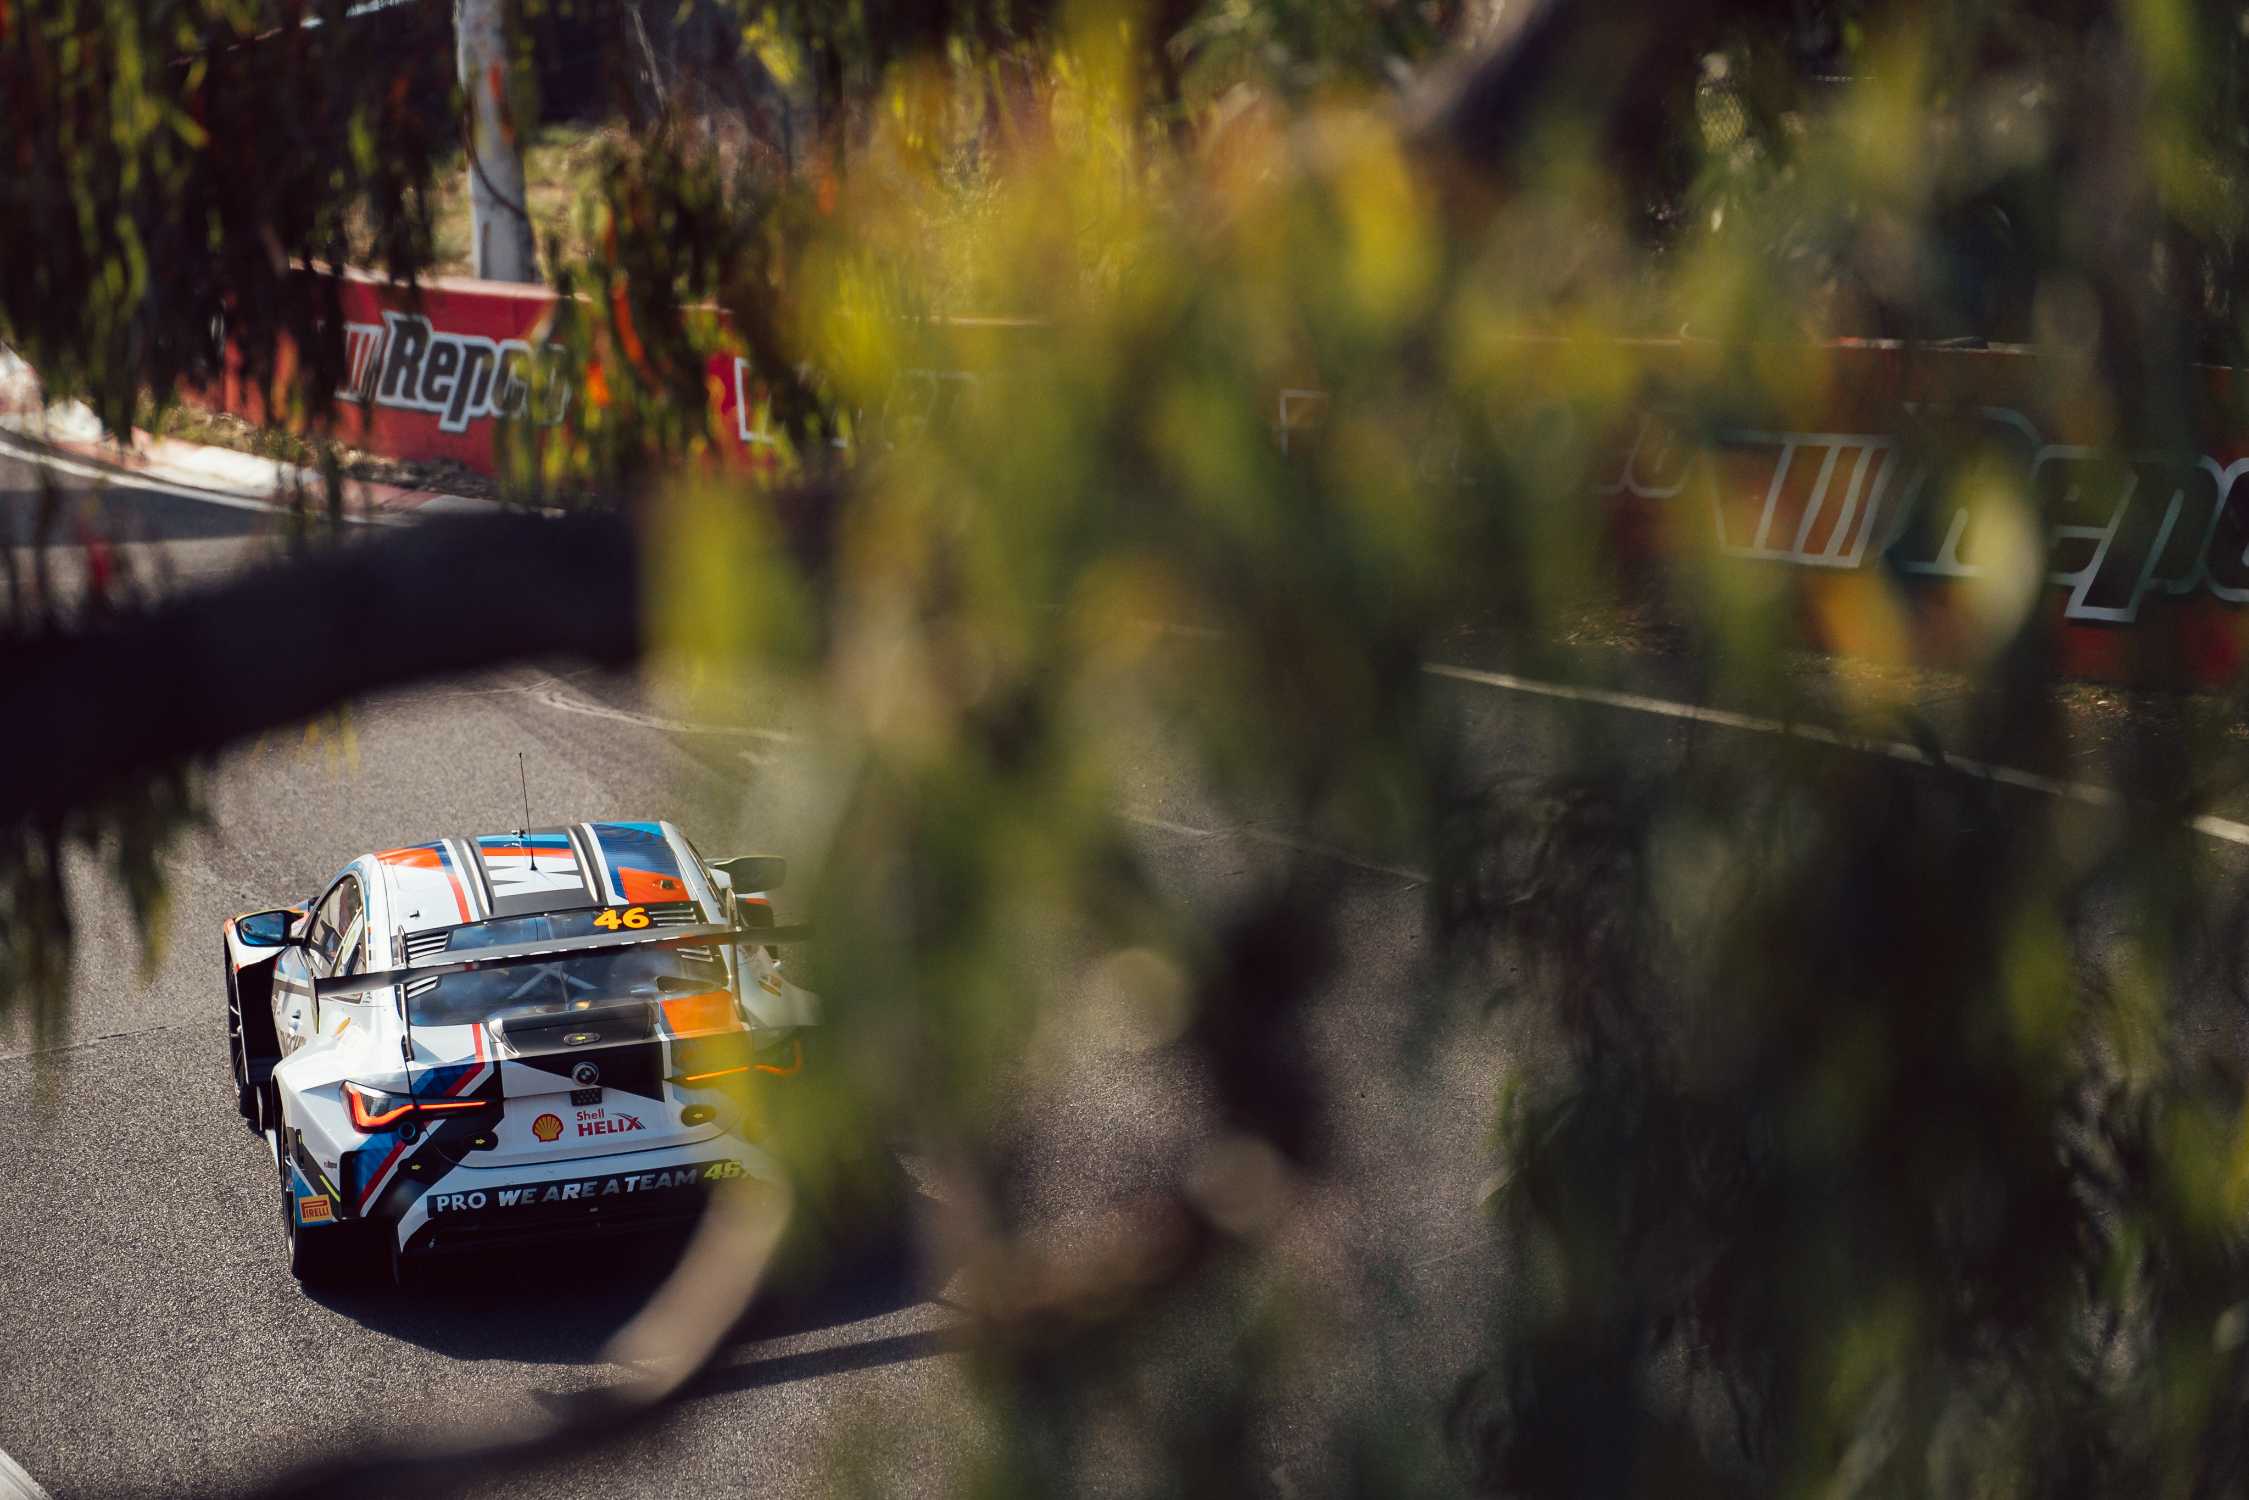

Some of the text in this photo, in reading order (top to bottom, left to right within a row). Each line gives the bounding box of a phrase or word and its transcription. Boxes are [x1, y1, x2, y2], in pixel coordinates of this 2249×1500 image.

[593, 906, 650, 931] 46
[576, 1107, 605, 1121] Shell
[577, 1114, 646, 1137] HELIX
[436, 1191, 487, 1213] PRO
[498, 1187, 537, 1207] WE
[541, 1180, 598, 1201] ARE
[602, 1176, 621, 1195] A
[623, 1167, 697, 1193] TEAM
[301, 1199, 330, 1219] PIRELLI
